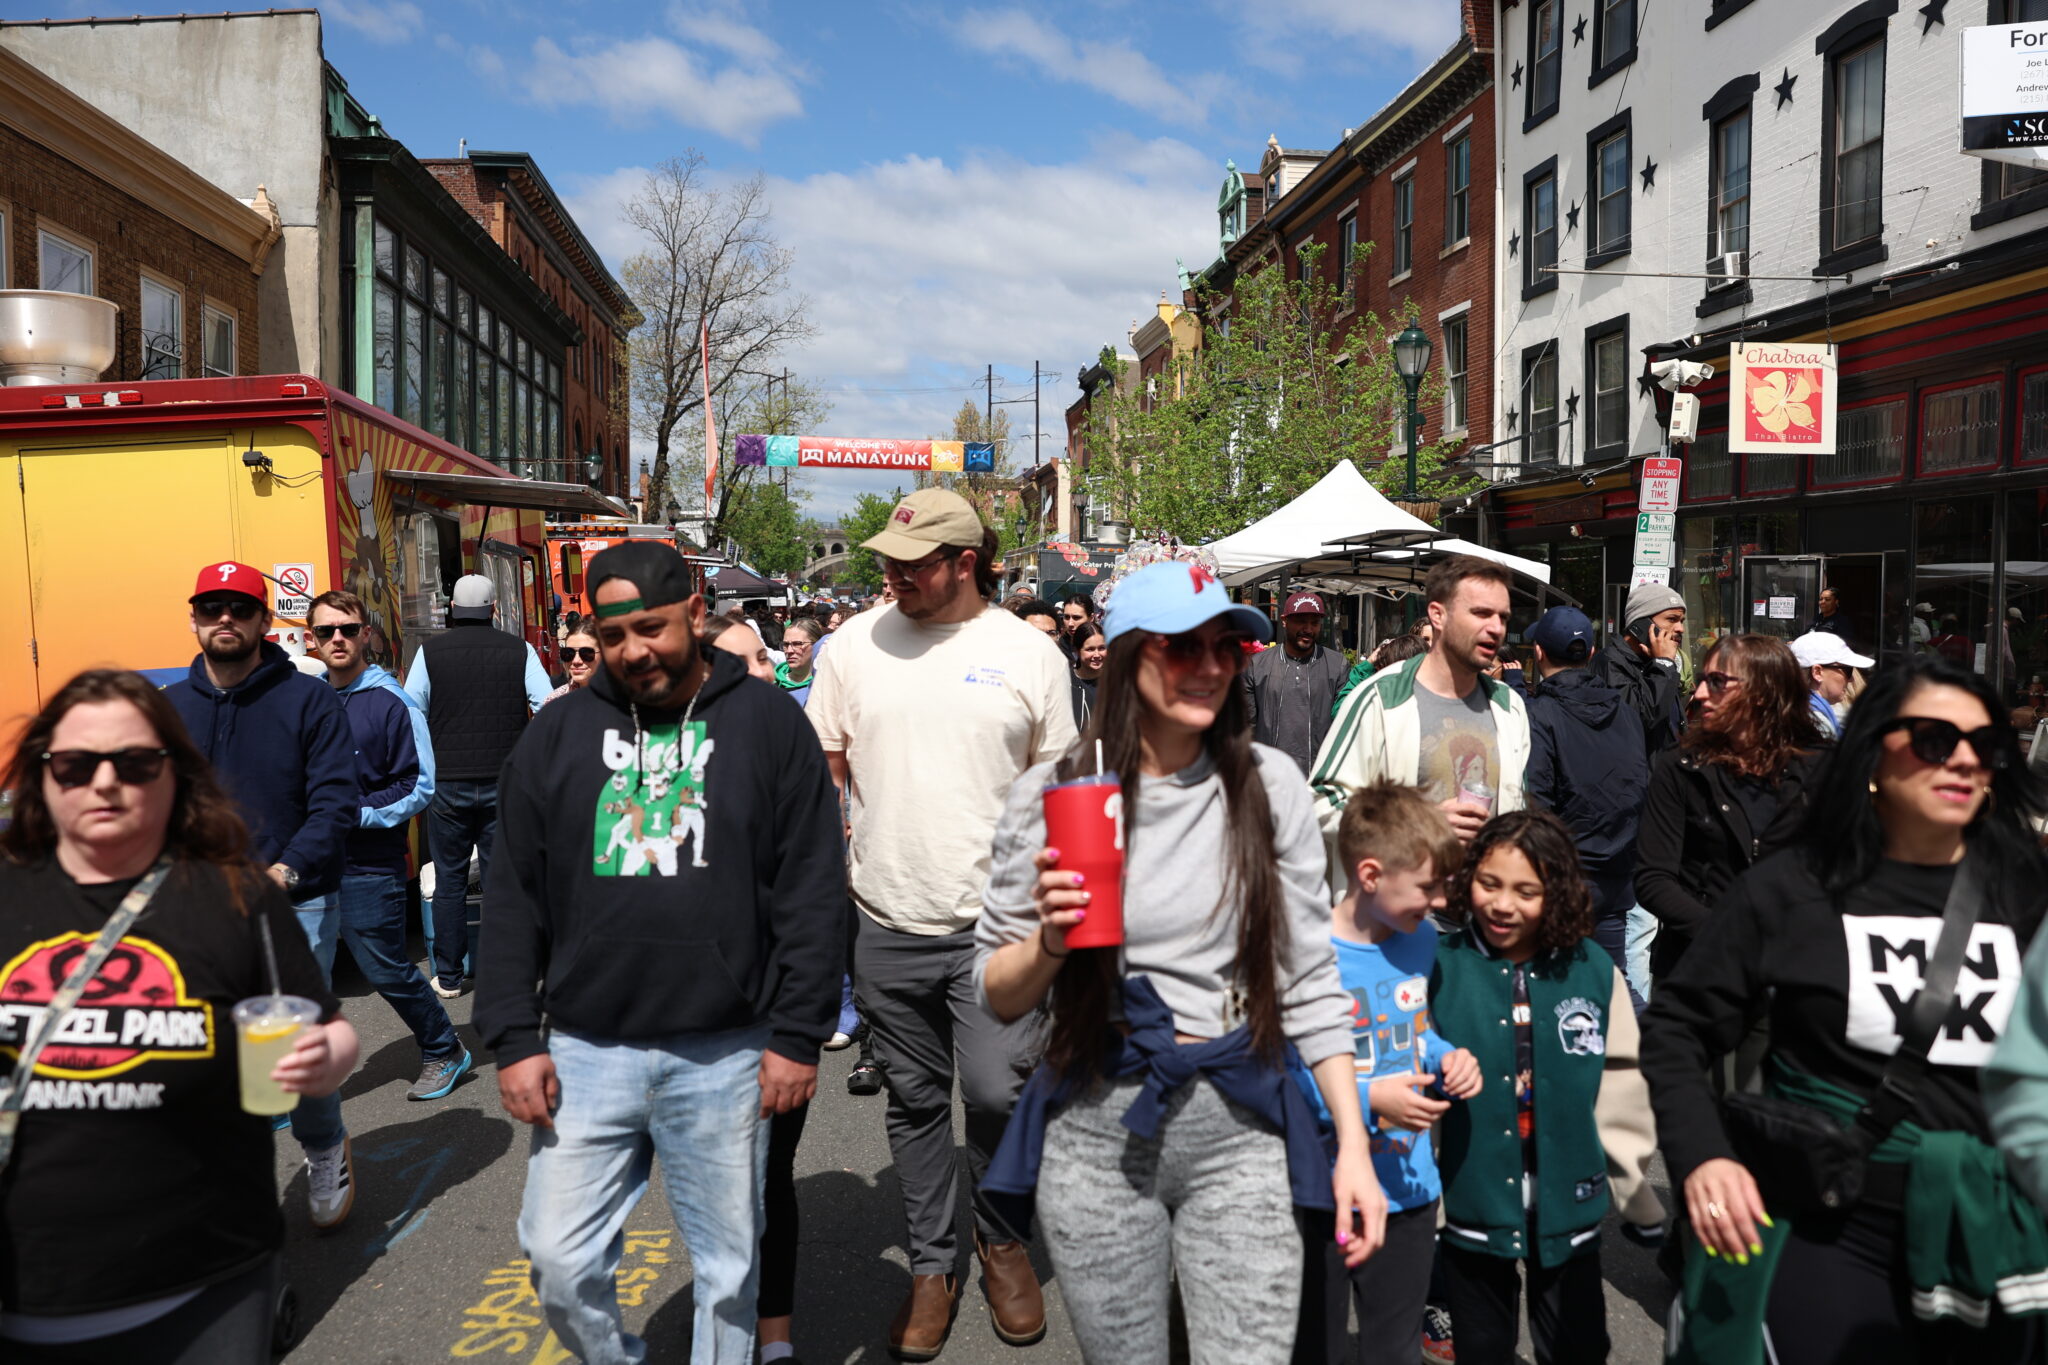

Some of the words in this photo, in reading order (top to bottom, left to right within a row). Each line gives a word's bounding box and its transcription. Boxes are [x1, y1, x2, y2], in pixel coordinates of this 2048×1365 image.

[2026, 59, 2042, 68] Joe
[1746, 347, 1823, 364] Chabaa
[1781, 433, 1813, 441] Bistro
[834, 440, 881, 449] WELCOME
[881, 442, 895, 450] TO
[827, 451, 929, 466] MANAYUNK
[1652, 480, 1669, 489] ANY
[1650, 490, 1669, 499] TIME
[1640, 516, 1648, 530] 2
[1649, 524, 1672, 532] PARKING
[218, 564, 238, 582] P
[278, 599, 293, 611] NO
[602, 728, 715, 774] birds
[651, 812, 662, 830] 1
[120, 1009, 209, 1047] PARK
